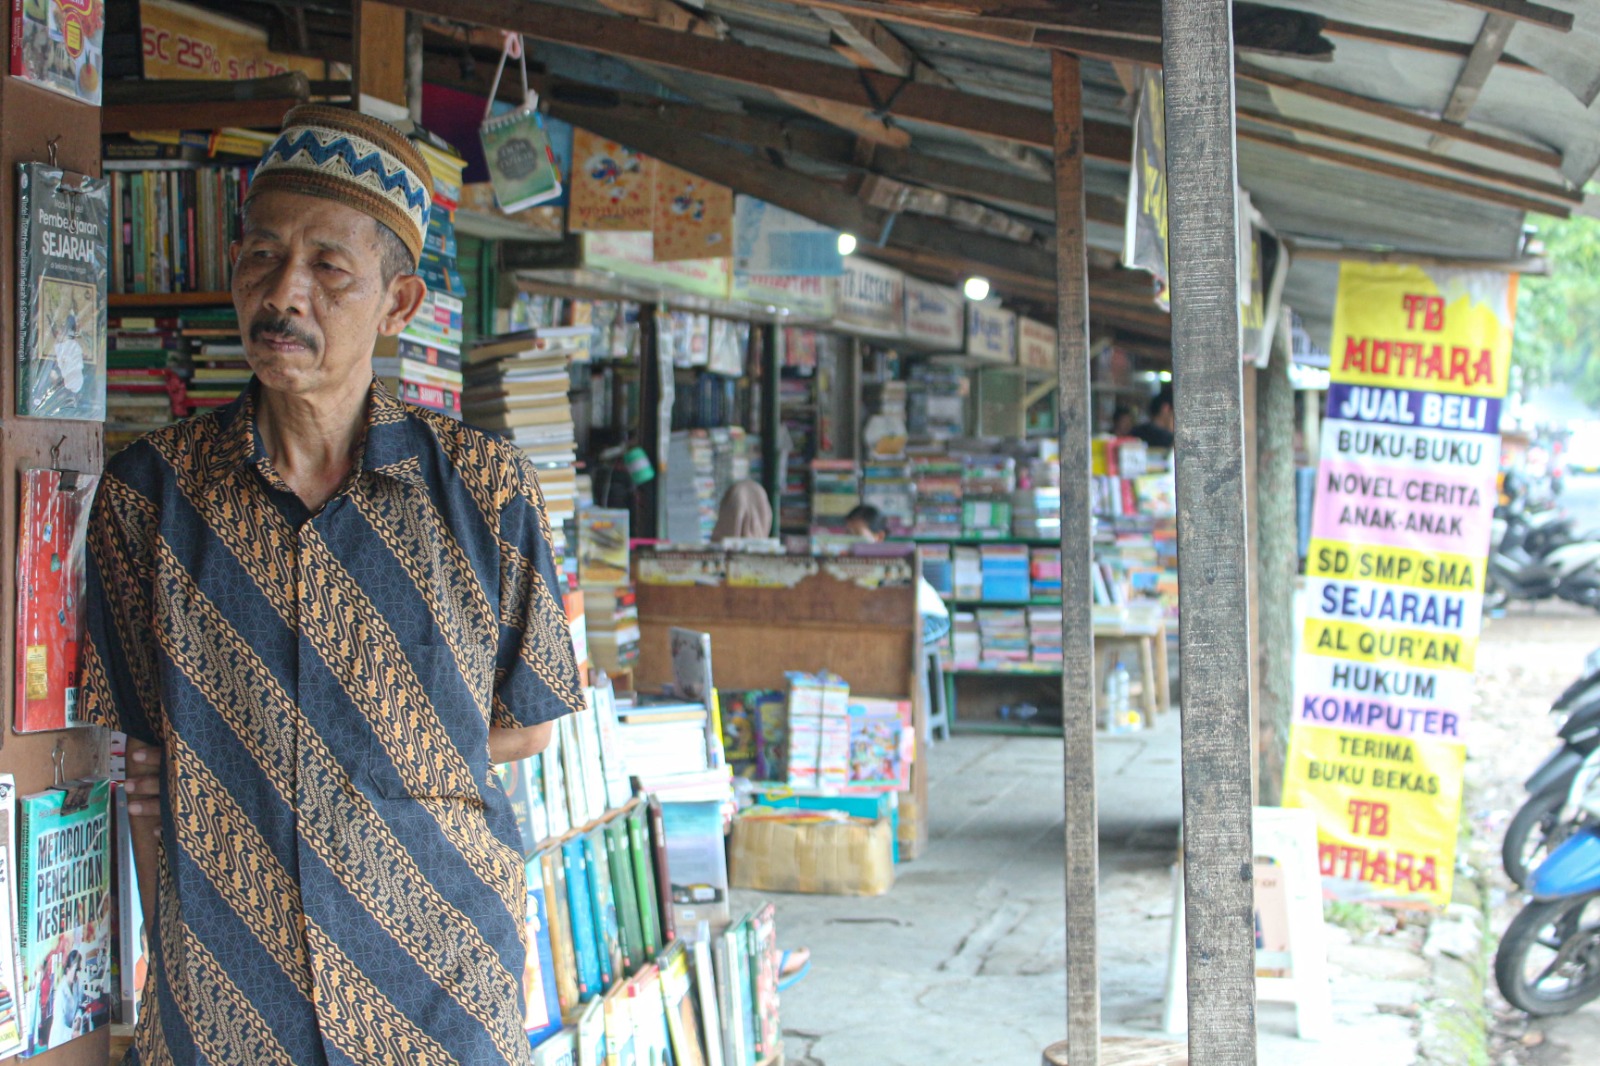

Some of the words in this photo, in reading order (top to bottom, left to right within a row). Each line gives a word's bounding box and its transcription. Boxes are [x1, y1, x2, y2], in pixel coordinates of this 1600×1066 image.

[141, 26, 169, 60] SC
[177, 37, 221, 75] 25%
[39, 209, 98, 235] Pembejaran
[42, 230, 94, 263] SEJARAH
[1403, 293, 1446, 331] TB
[1341, 387, 1415, 423] JUAL
[1421, 394, 1488, 431] BELI
[1338, 429, 1483, 465] BUKU-BUKU
[1339, 505, 1462, 536] ANAK-ANAK
[1320, 583, 1464, 629] SEJARAH
[1317, 628, 1349, 651] AL
[1358, 632, 1459, 664] QUR'AN
[1331, 664, 1436, 698] HUKUM
[1302, 695, 1459, 736] KOMPUTER
[1338, 735, 1414, 763] TERIMA
[1308, 762, 1365, 784] BUKU
[1372, 767, 1439, 795] BEKAS
[1348, 799, 1389, 836] TB
[38, 818, 102, 871] METODOLOGI
[37, 853, 102, 908] PENELITIAN
[1319, 842, 1437, 891] UTIARA
[37, 889, 103, 942] KESEHATAN
